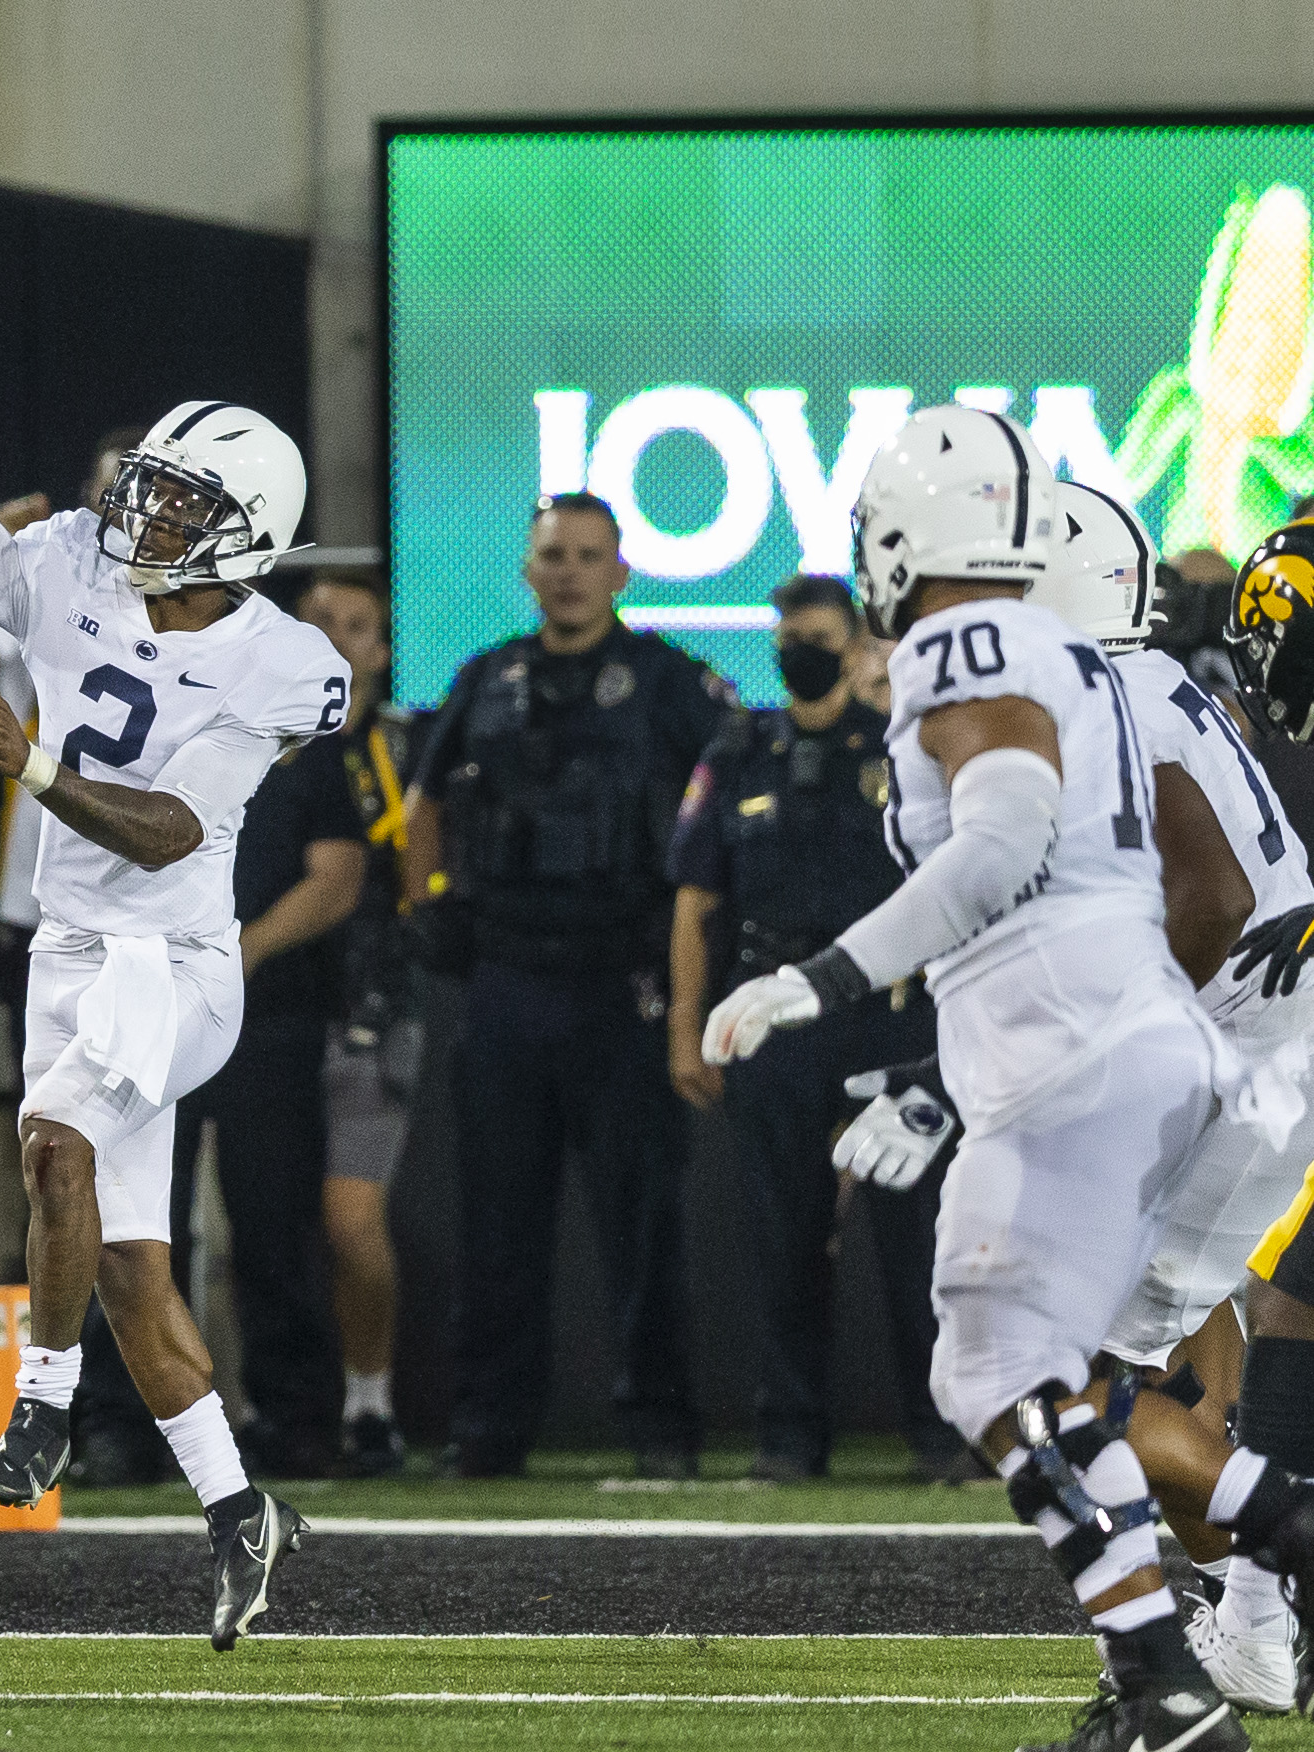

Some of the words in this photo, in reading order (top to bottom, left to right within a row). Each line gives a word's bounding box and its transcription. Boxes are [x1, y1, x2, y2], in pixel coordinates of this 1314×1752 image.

[315, 677, 346, 731] 2
[915, 621, 1006, 694] 70
[61, 663, 157, 772] 2
[1063, 642, 1153, 851] 7
[1168, 679, 1287, 867] 7
